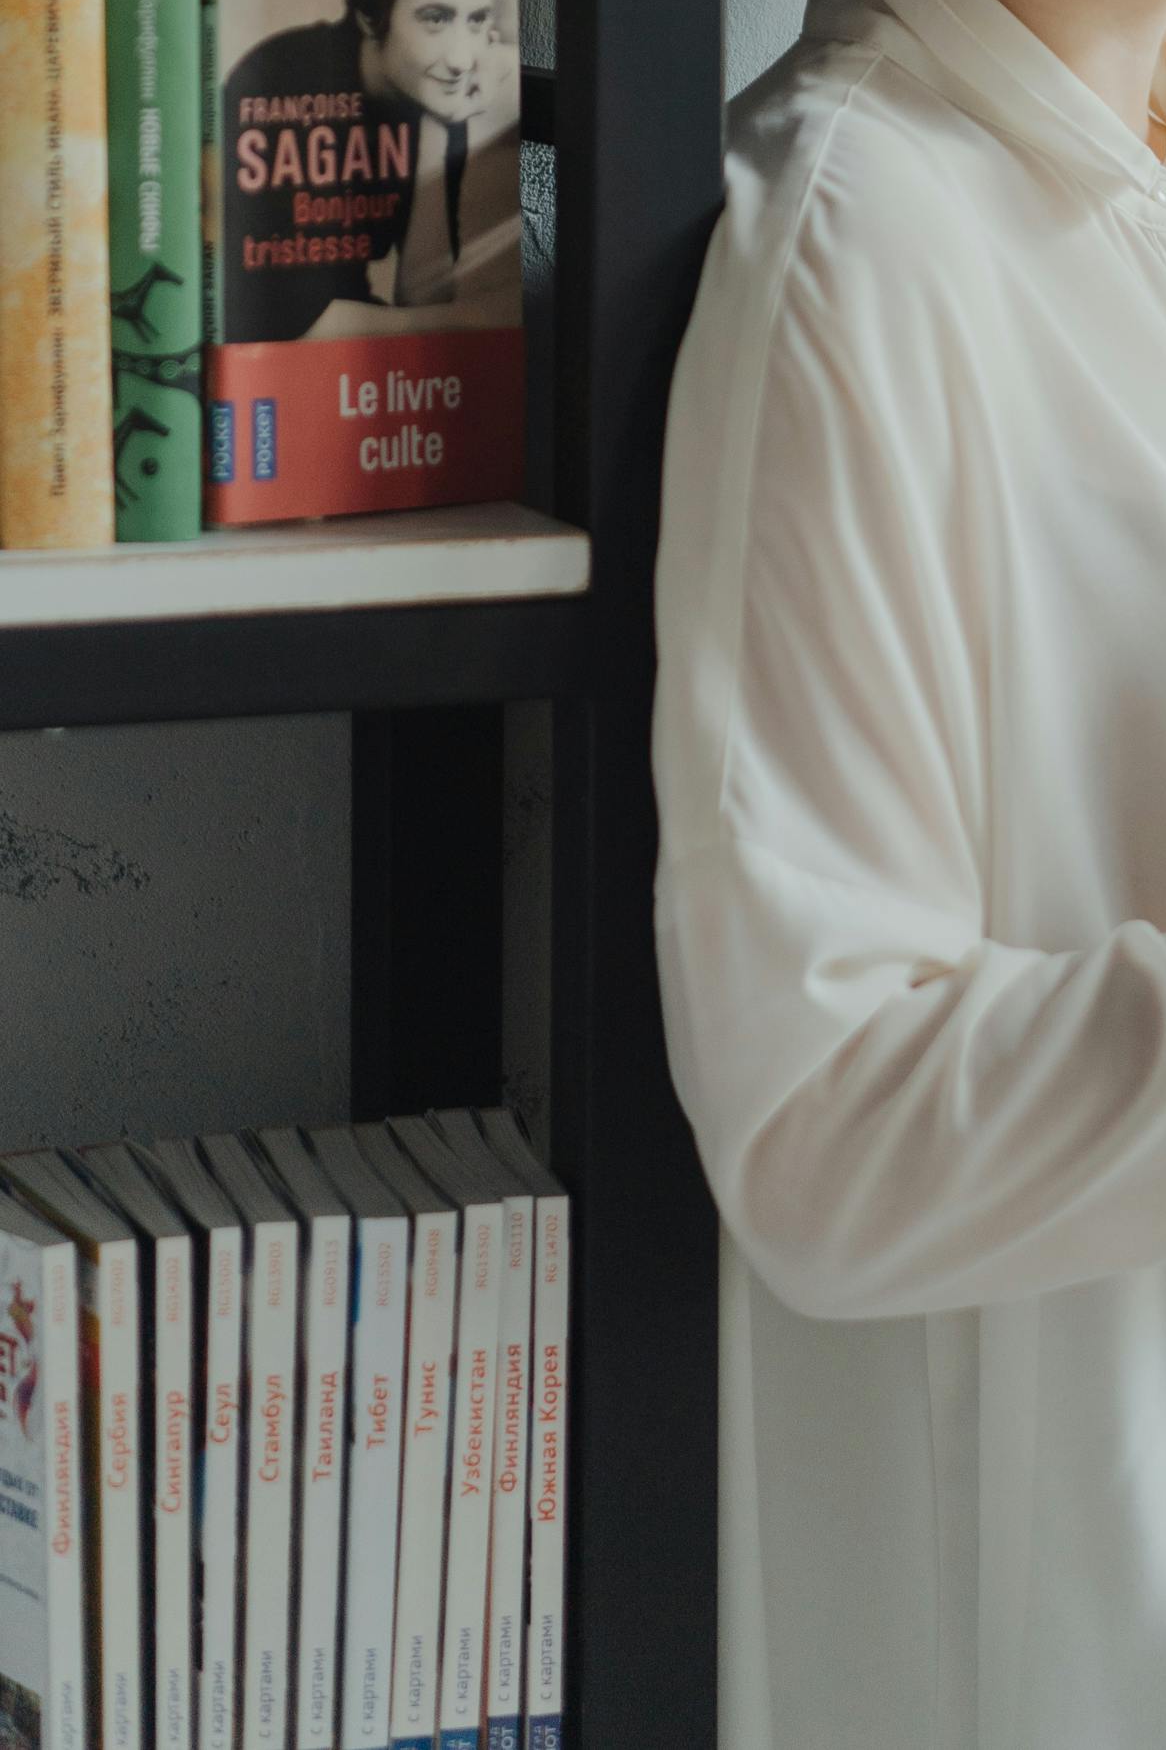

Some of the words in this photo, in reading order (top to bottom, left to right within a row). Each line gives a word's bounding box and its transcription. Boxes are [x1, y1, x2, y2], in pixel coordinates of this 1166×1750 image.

[239, 92, 363, 126] FRANÇOISE
[236, 123, 410, 193] SAGAN
[293, 191, 399, 227] Bonjour
[243, 233, 371, 271] tristesse
[338, 372, 378, 418] Le
[386, 369, 462, 413] livre
[212, 407, 229, 477] POCKET
[256, 404, 273, 475] POCKET
[359, 423, 444, 473] culte
[509, 1211, 525, 1271] RG1110
[544, 1260, 561, 1285] RG
[209, 1383, 234, 1445] Сеул
[366, 1373, 390, 1450] Тибет
[414, 1360, 438, 1438] Тунис
[499, 1342, 523, 1494] Финляндия
[538, 1343, 563, 1424] Корея
[107, 1391, 130, 1491] Сербия
[161, 1389, 189, 1514] Сингапур
[259, 1373, 285, 1484] Стамбул
[312, 1370, 339, 1484] Таиланд
[460, 1348, 488, 1498] Узбекистан
[538, 1430, 560, 1523] Южная
[259, 1650, 275, 1726] картами
[310, 1647, 327, 1724] картами
[361, 1647, 378, 1724] картами
[408, 1634, 424, 1710] картами
[456, 1626, 472, 1702] картами
[497, 1614, 512, 1690] картами
[539, 1613, 554, 1690] картами
[210, 1660, 226, 1736] картами
